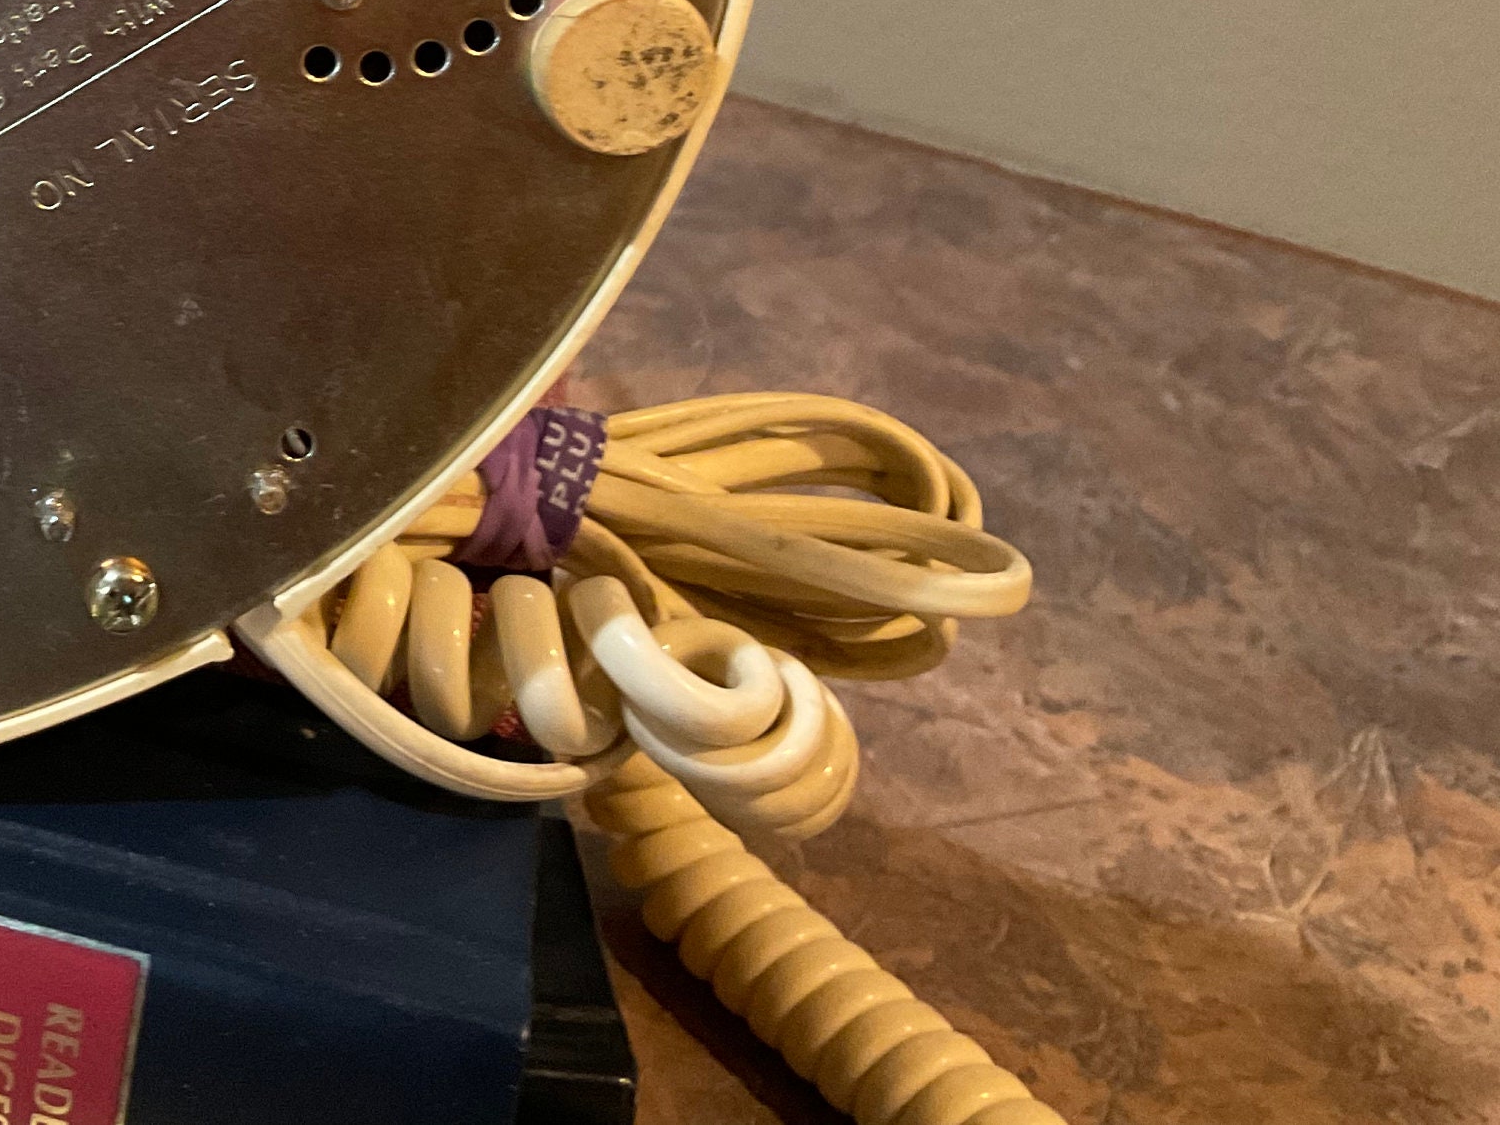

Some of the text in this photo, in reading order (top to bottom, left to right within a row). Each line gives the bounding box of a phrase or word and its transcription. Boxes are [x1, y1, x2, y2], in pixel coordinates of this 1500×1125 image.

[11, 43, 93, 88] Part
[30, 58, 258, 211] SERIAL NO
[548, 431, 591, 511] PLU
